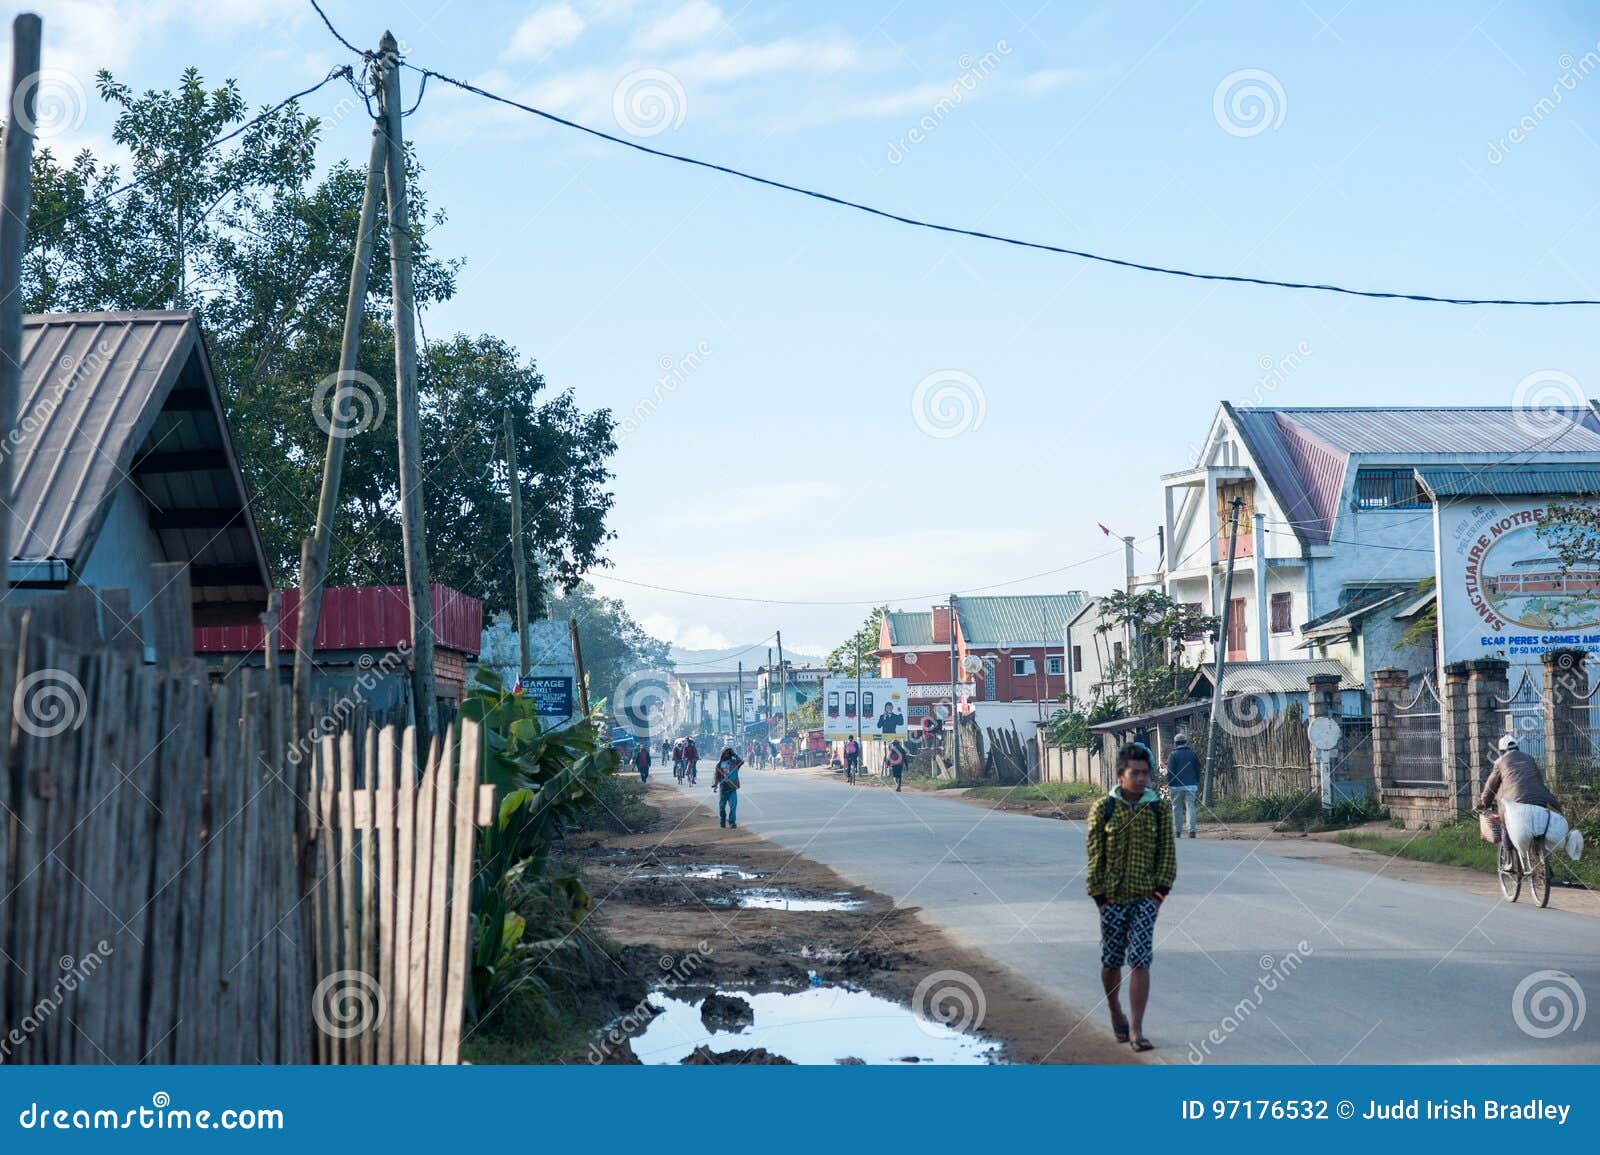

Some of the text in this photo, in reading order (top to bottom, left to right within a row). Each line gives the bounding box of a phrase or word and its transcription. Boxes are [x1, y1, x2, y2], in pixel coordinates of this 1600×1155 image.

[1471, 505, 1484, 518] DE
[1465, 508, 1544, 632] SANCTUAIRE NOTRE
[1481, 636, 1506, 646] ECAR
[522, 680, 565, 688] GARAGE
